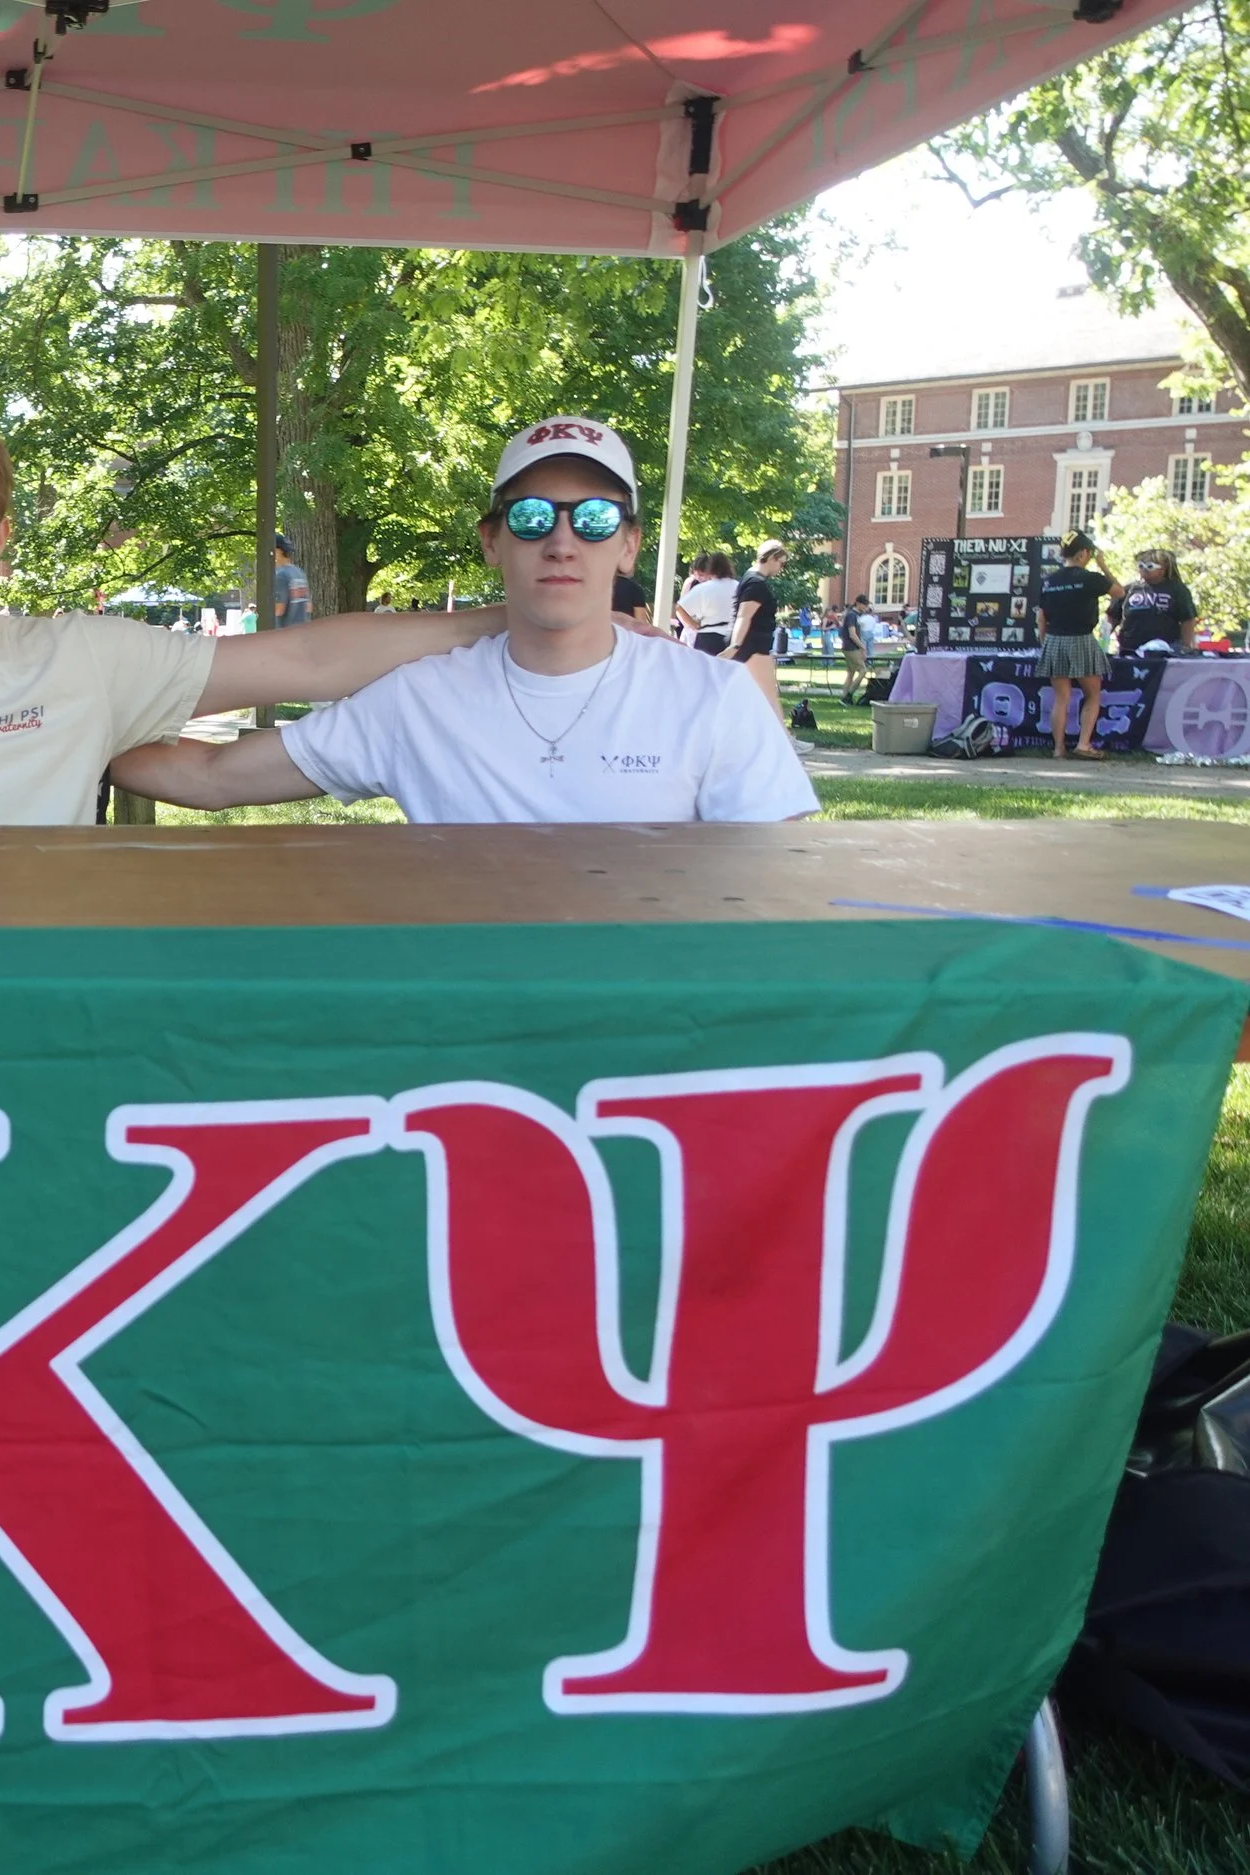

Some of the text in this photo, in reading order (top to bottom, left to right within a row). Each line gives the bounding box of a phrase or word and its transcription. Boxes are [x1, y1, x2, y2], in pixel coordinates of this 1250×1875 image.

[526, 423, 603, 446] ΦΚΨ
[21, 705, 44, 721] PSI
[621, 755, 661, 767] ΦΚΨ
